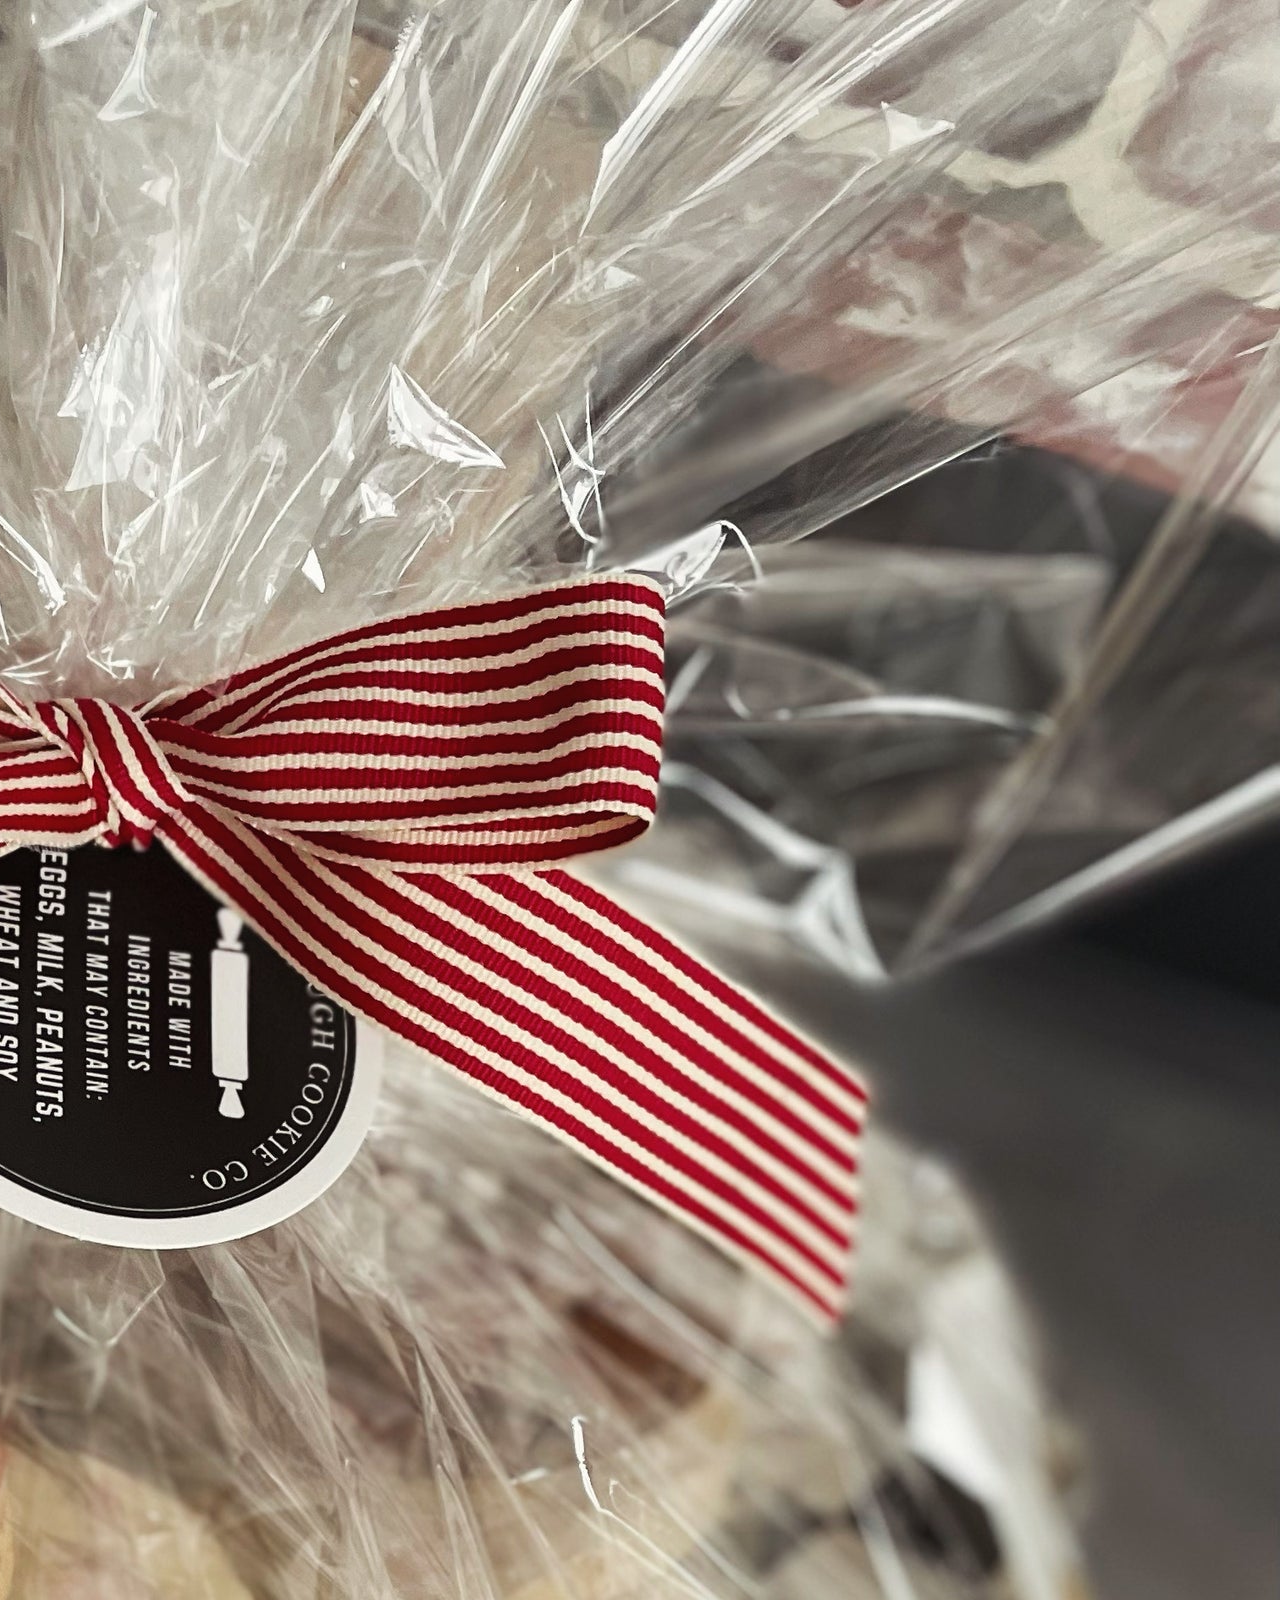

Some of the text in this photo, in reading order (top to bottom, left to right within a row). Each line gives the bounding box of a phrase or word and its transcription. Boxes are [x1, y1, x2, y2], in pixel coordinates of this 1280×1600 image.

[32, 849, 68, 1123] EGGS, MILK, PEANUTS,
[85, 891, 111, 1101] THAT MAY CONTAIN:
[127, 934, 151, 1072] INGREDIENTS
[168, 951, 192, 1069] MADE WITH
[251, 1062, 331, 1167] COOKIE
